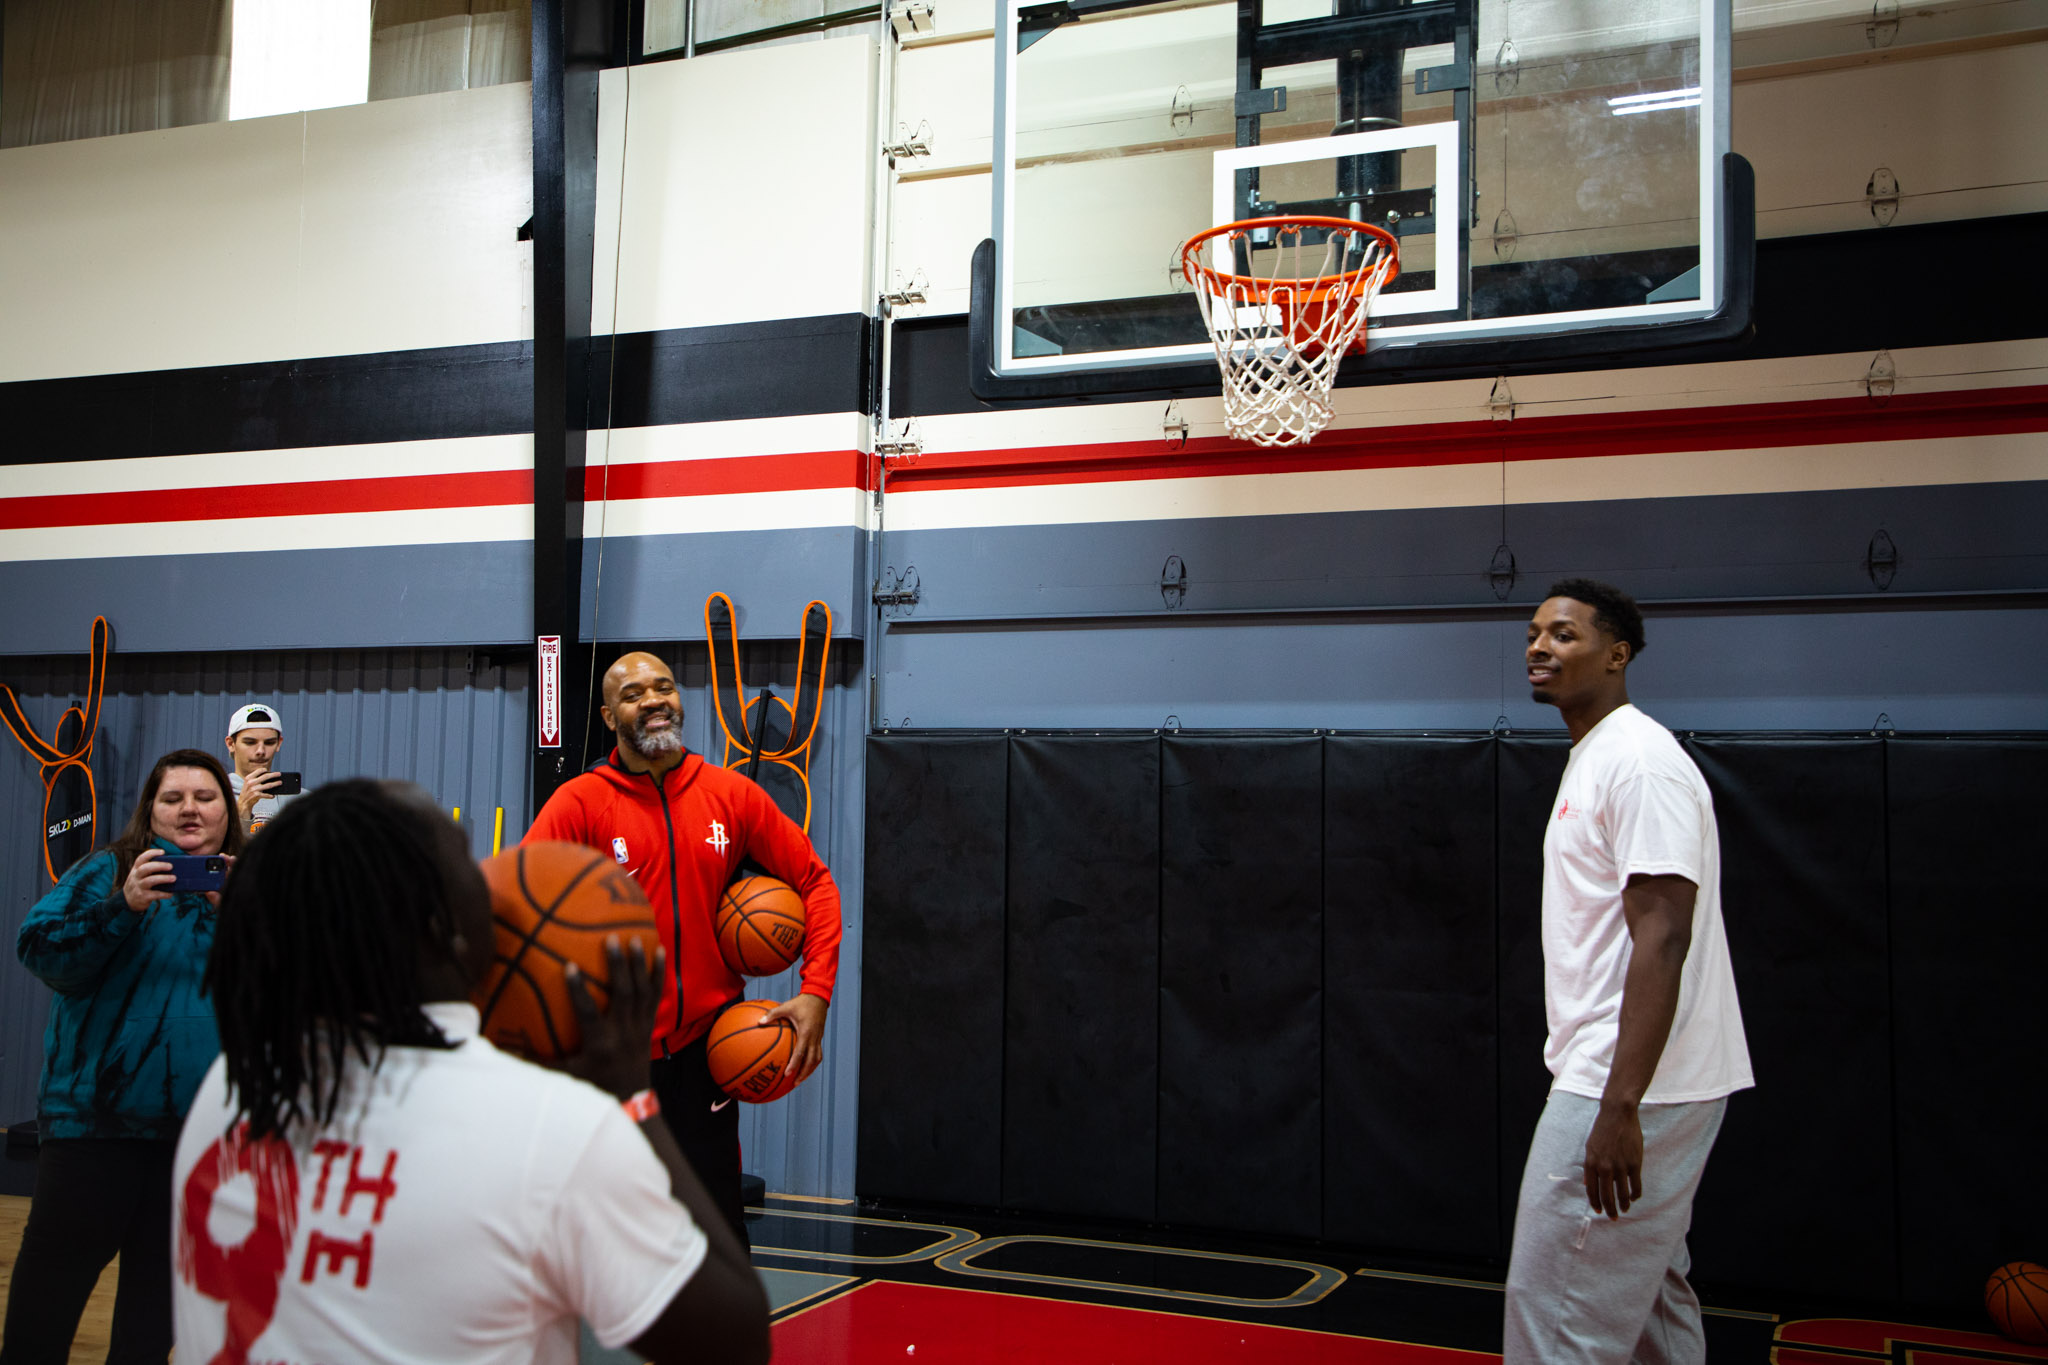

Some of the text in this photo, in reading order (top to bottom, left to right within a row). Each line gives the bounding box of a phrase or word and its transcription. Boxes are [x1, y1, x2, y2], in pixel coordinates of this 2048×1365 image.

[542, 644, 557, 654] FIRE
[48, 812, 92, 838] SKLZ D-MAN
[771, 922, 800, 950] THE
[742, 1060, 781, 1095] ROCK
